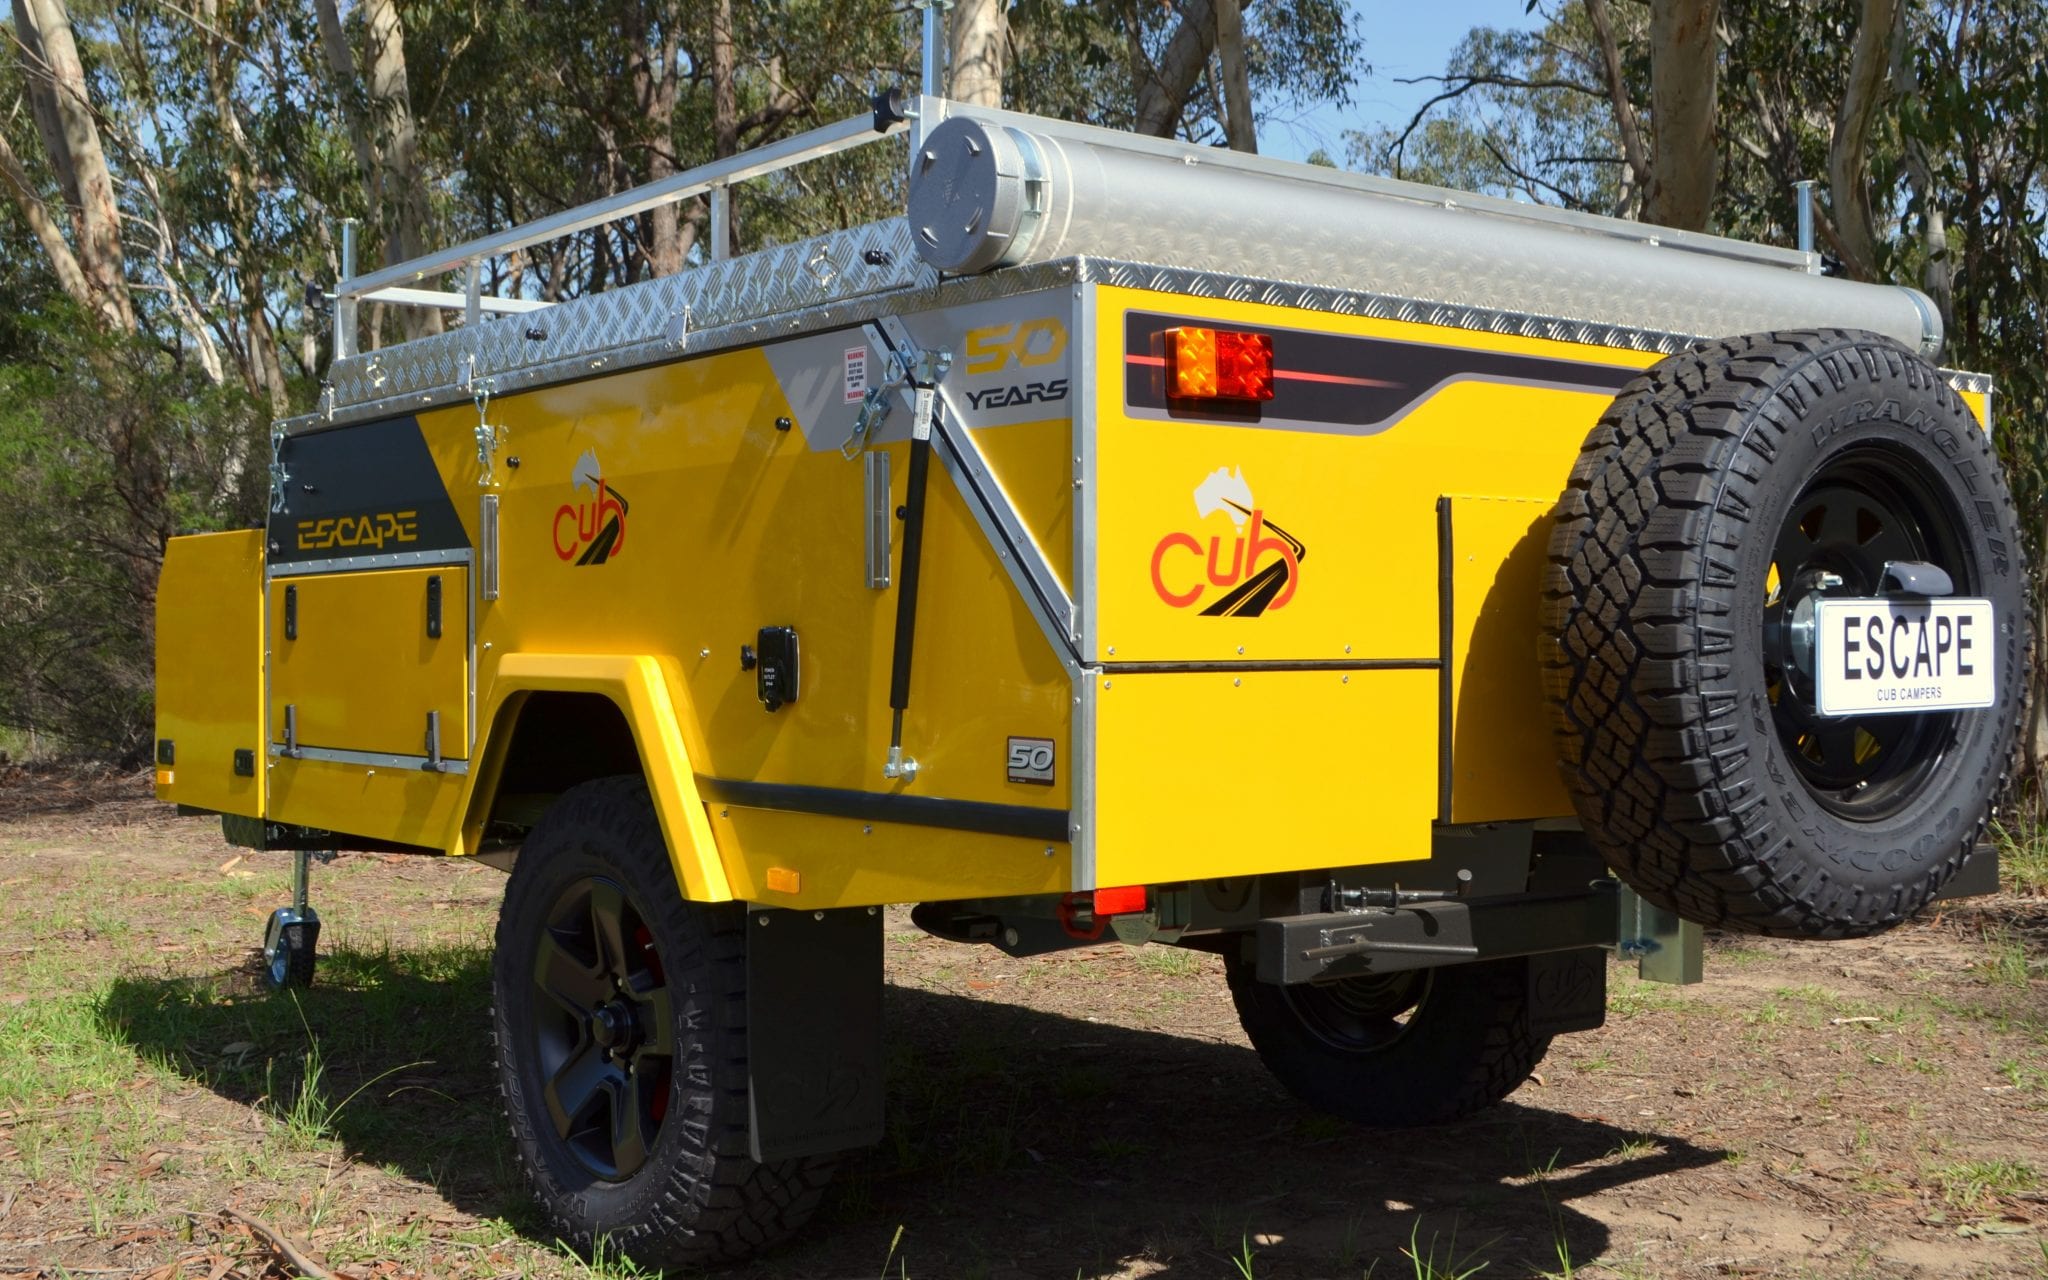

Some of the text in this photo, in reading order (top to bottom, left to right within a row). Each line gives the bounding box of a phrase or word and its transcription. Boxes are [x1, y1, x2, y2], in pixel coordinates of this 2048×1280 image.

[966, 317, 1069, 376] 50
[965, 379, 1068, 410] YEARS
[1809, 398, 2010, 577] WRANGLER
[298, 511, 416, 549] ESCAPE
[1844, 615, 1973, 680] ESCAPE
[1877, 686, 1942, 701] CUB CAMPERS
[1008, 745, 1053, 771] 50
